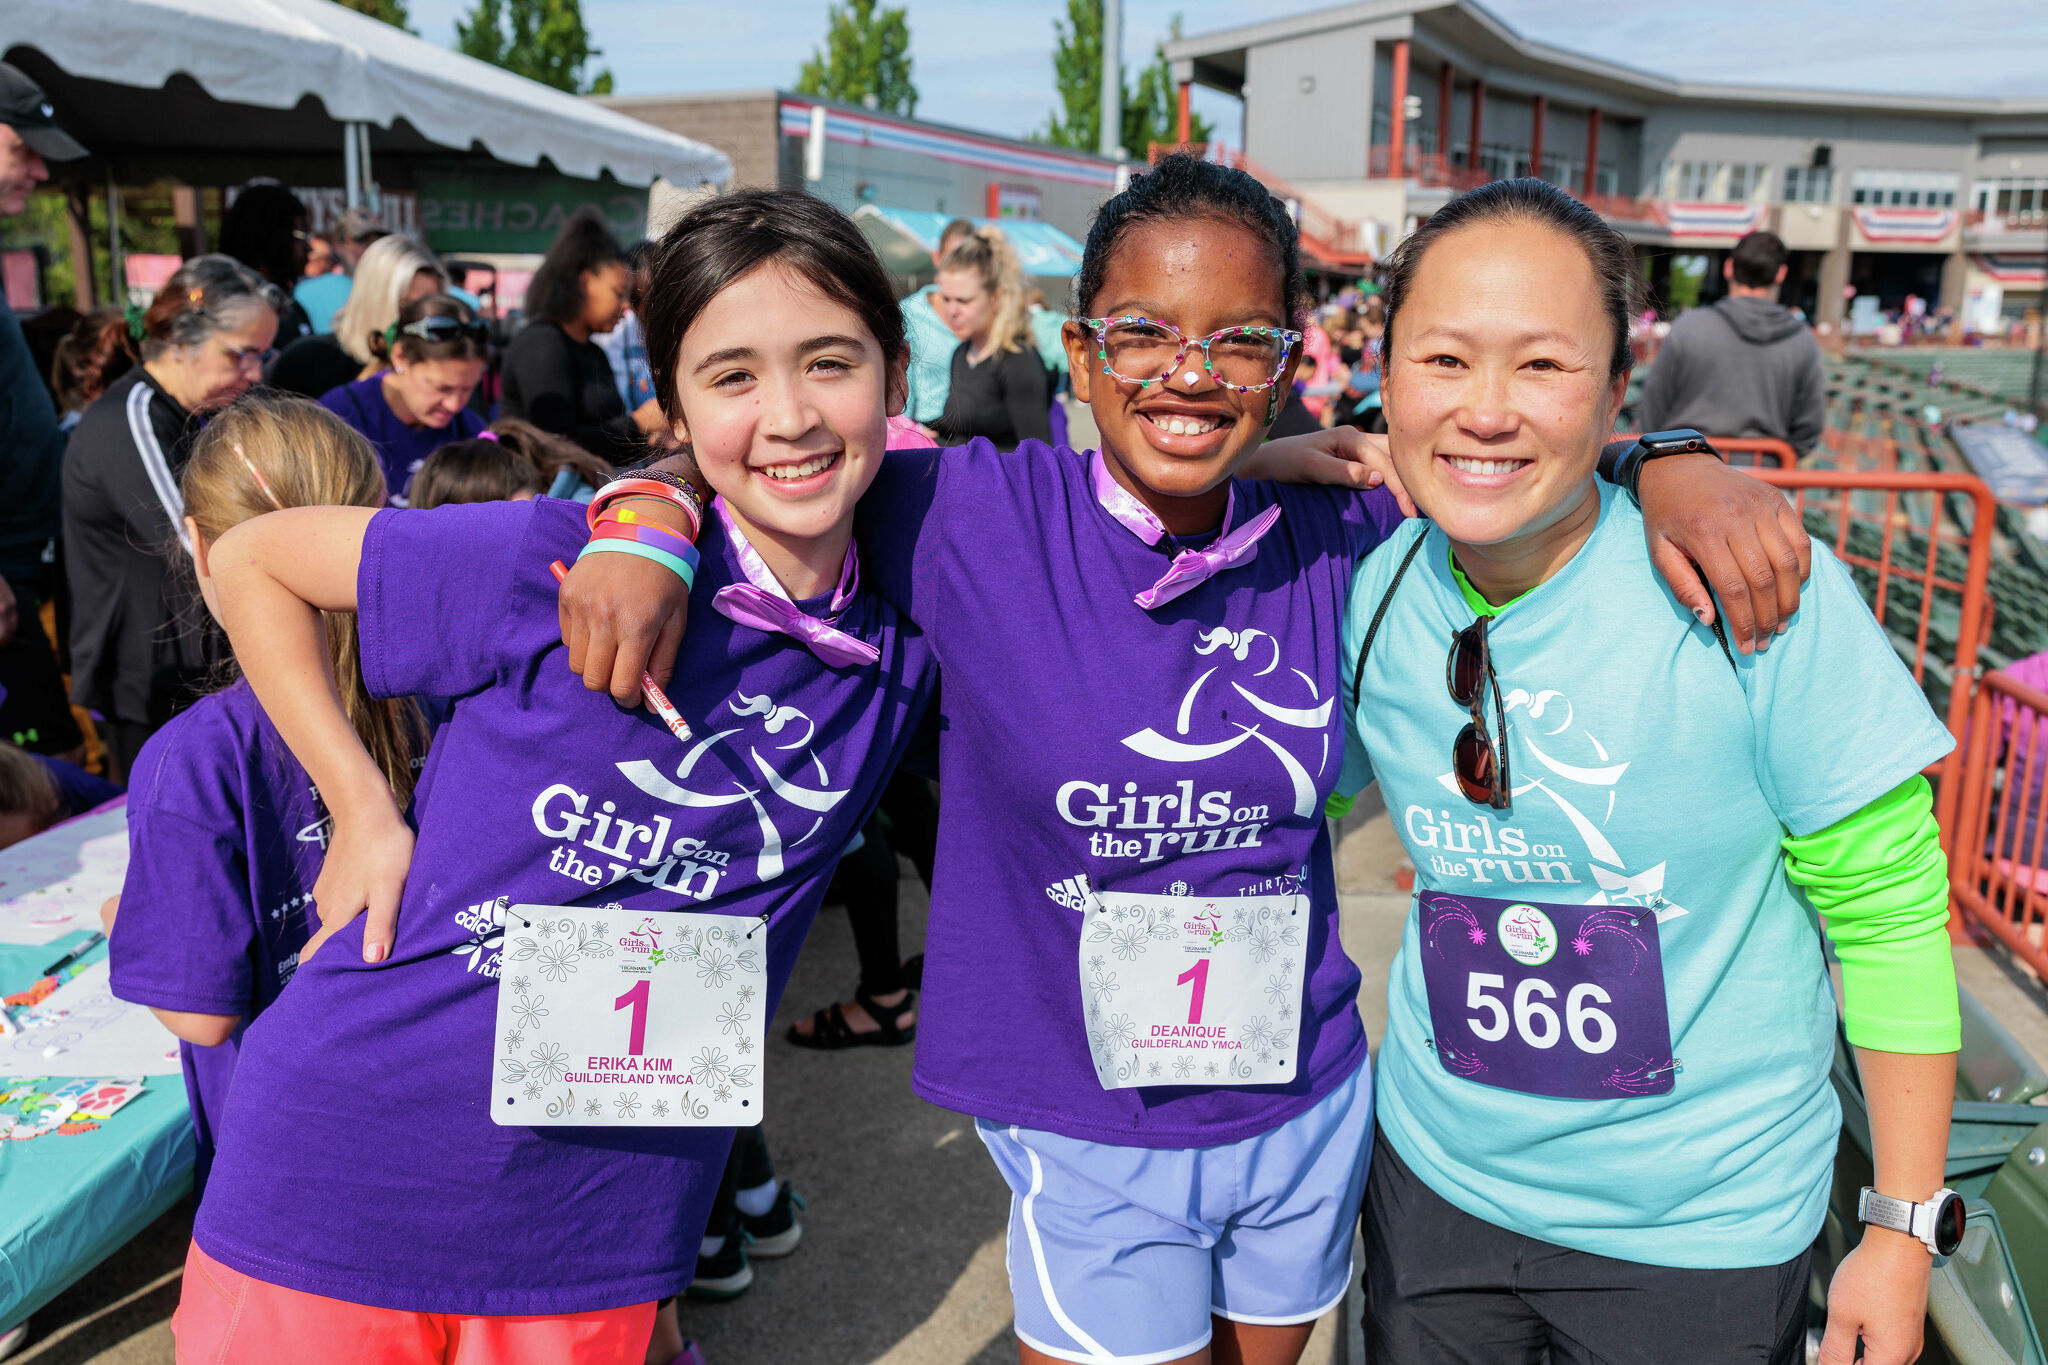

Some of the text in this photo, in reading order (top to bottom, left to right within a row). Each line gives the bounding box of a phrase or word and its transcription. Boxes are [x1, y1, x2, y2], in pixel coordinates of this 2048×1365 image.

[1056, 779, 1269, 829] Girls on
[532, 784, 731, 867] Girls on
[1405, 804, 1567, 858] Girls on
[1088, 823, 1263, 863] the run
[549, 846, 602, 886] the
[1430, 854, 1582, 884] the run
[1239, 876, 1291, 897] THIRT
[1184, 921, 1206, 930] Girls
[1505, 924, 1527, 934] Girls
[619, 937, 645, 947] Girls
[631, 946, 650, 954] run
[1176, 958, 1210, 1025] 1
[614, 979, 650, 1056] 1
[1466, 971, 1618, 1055] 566
[1150, 1025, 1227, 1038] DEANIQUE
[1131, 1039, 1242, 1050] GUILDERLAND YMCA
[587, 1056, 673, 1072] ERIKA KIM
[564, 1072, 694, 1085] GUILDERLAND YMCA
